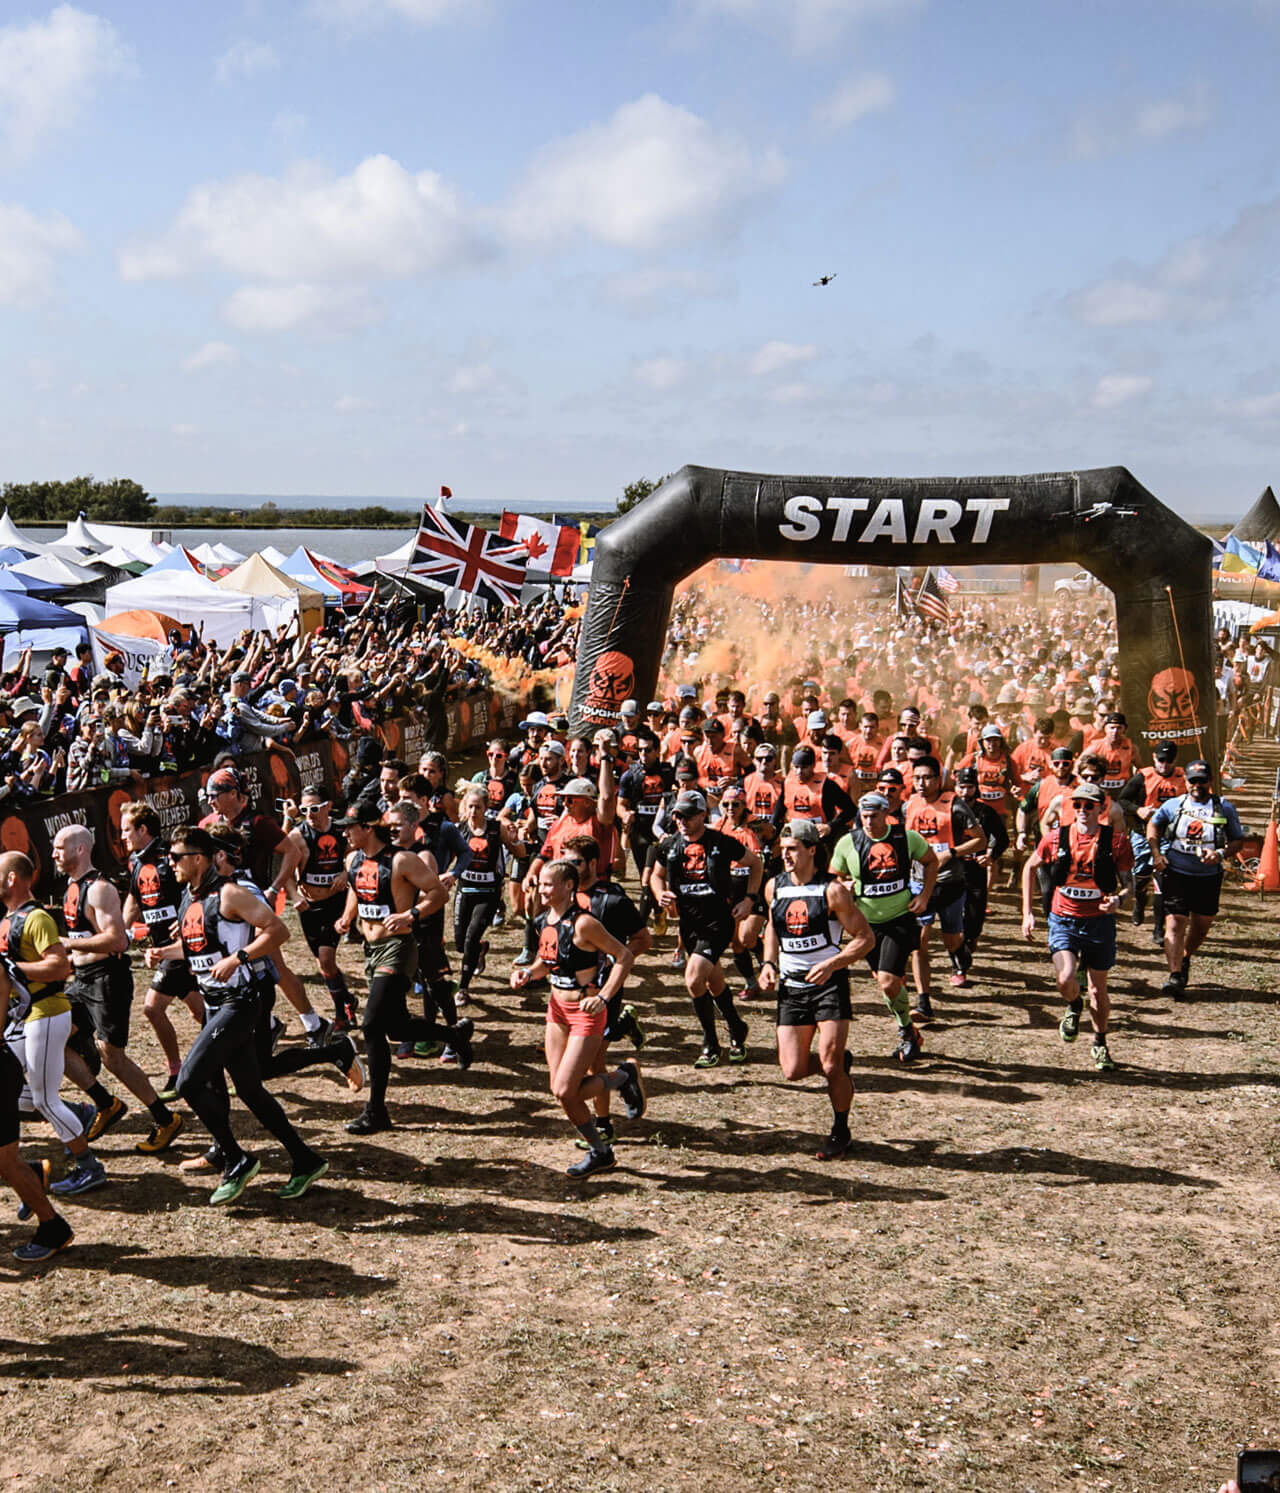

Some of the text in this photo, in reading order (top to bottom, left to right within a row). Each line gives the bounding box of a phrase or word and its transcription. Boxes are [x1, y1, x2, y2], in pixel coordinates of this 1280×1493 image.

[778, 495, 1010, 543] START
[1141, 726, 1208, 739] TOUGHEST
[160, 805, 190, 827] UGHEST
[788, 937, 818, 949] 4558
